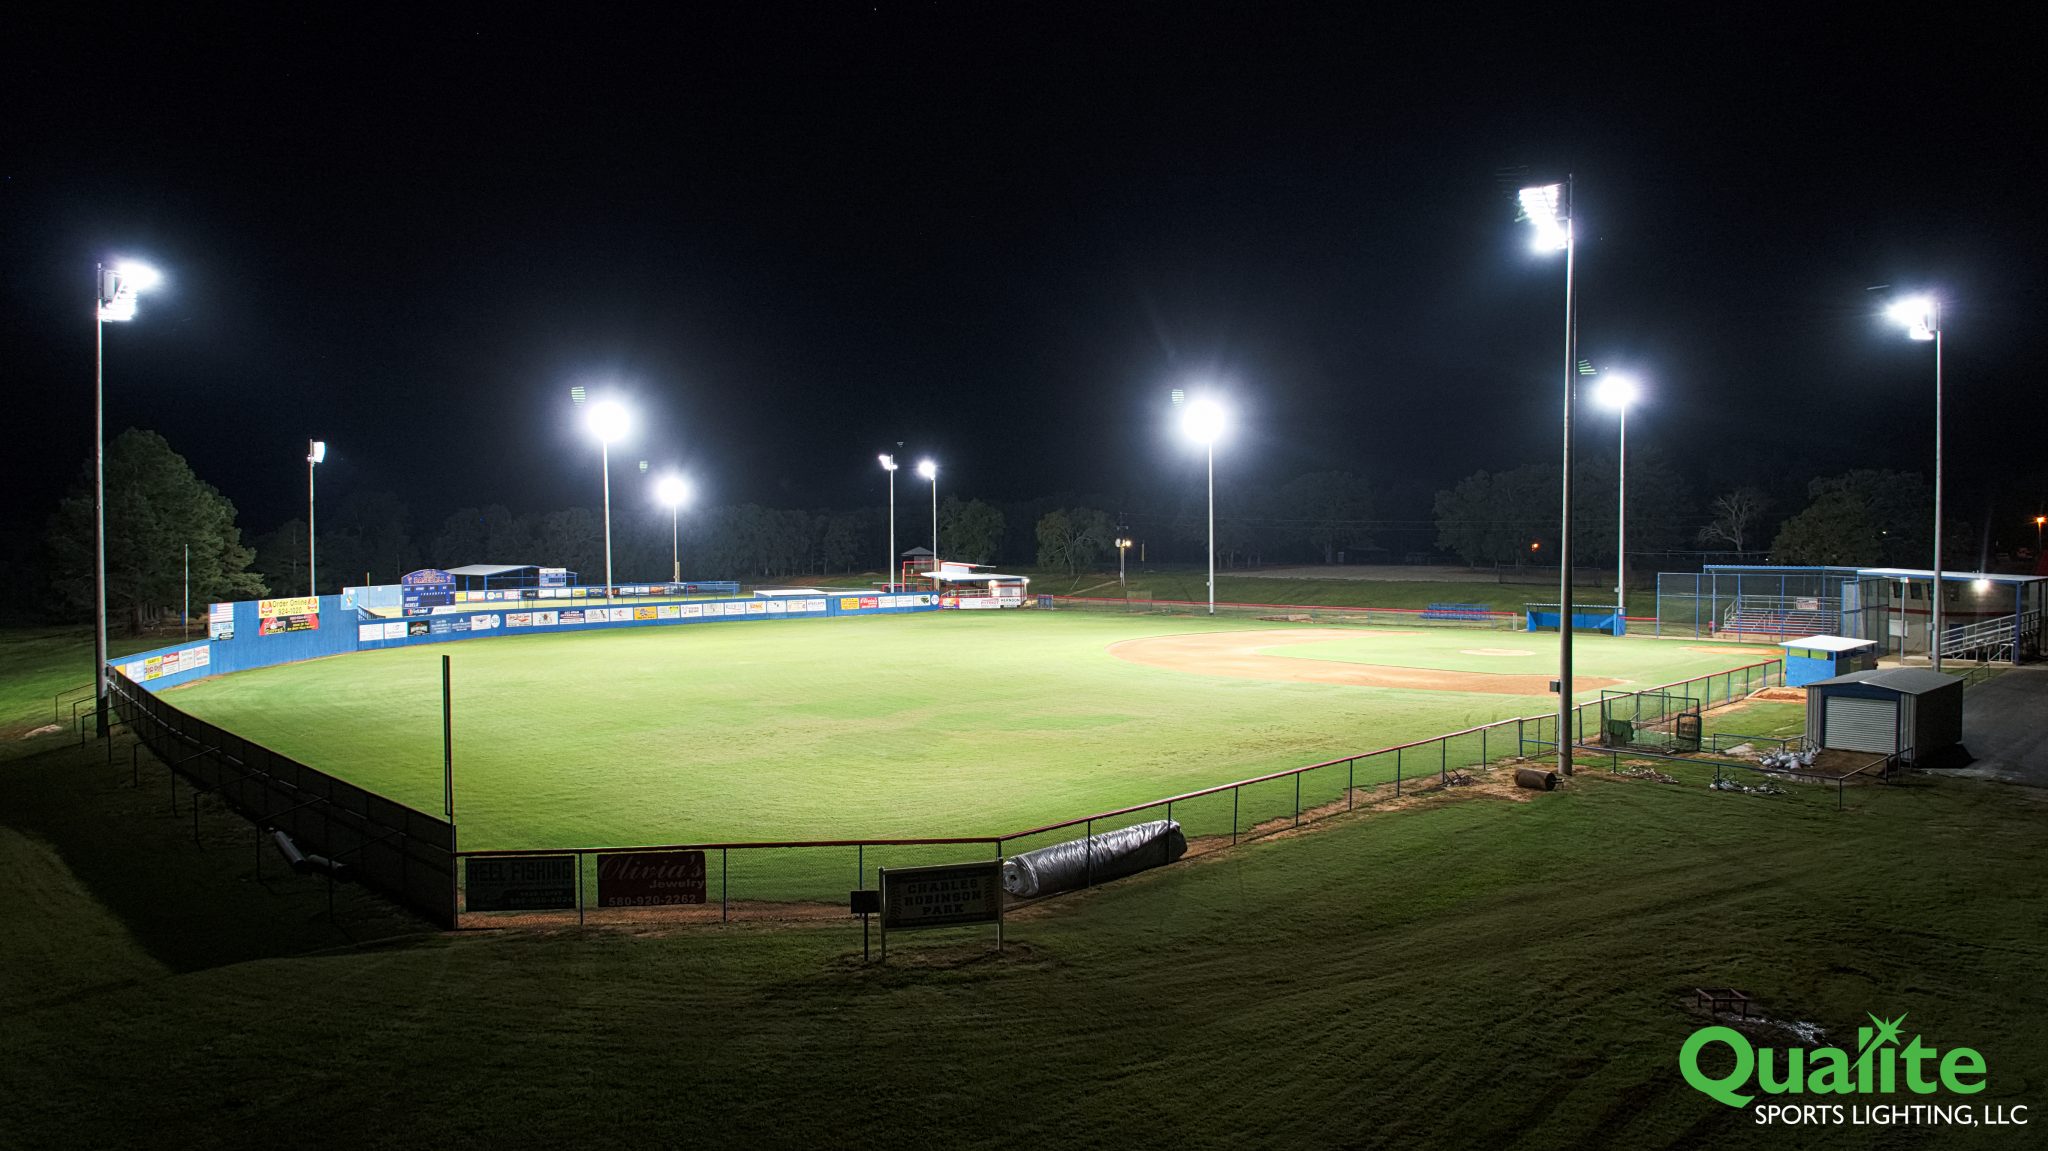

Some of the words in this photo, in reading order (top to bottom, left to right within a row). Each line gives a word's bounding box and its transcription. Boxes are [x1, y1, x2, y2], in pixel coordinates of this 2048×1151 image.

[273, 600, 288, 608] Order
[511, 861, 572, 881] FISHING
[599, 854, 703, 881] Olivia's
[649, 878, 705, 889] Jewelry
[907, 879, 978, 894] CHARLES
[904, 890, 982, 906] ROBINSON
[922, 903, 965, 915] PARK
